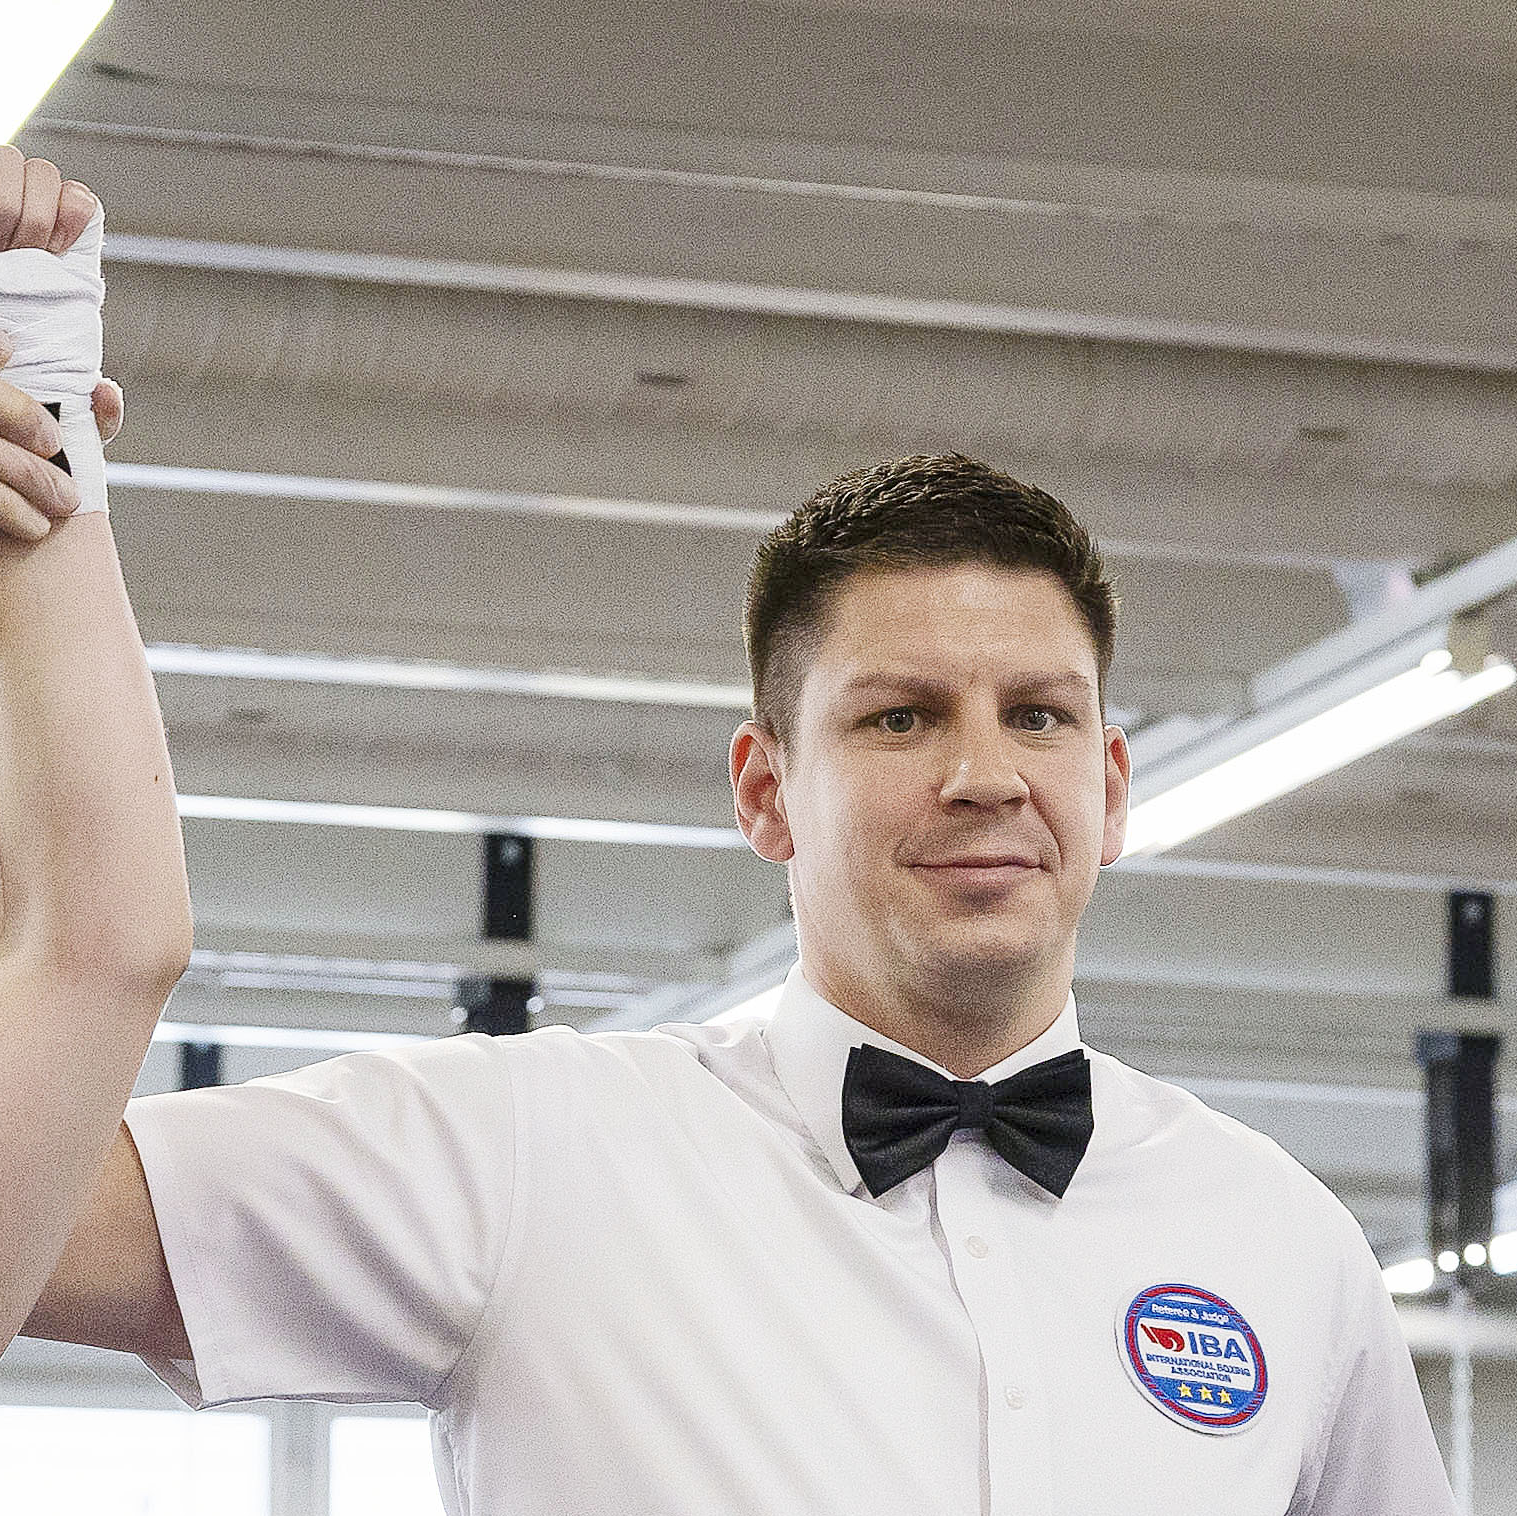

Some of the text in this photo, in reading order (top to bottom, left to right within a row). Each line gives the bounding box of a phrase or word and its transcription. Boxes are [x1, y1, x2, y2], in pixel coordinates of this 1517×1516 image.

[1151, 1303, 1230, 1325] Referee & Judge
[1187, 1331, 1248, 1363] IBA
[1145, 1353, 1251, 1377] INTERNATIONAL BOXING
[1171, 1366, 1232, 1383] ASSOCIATION
